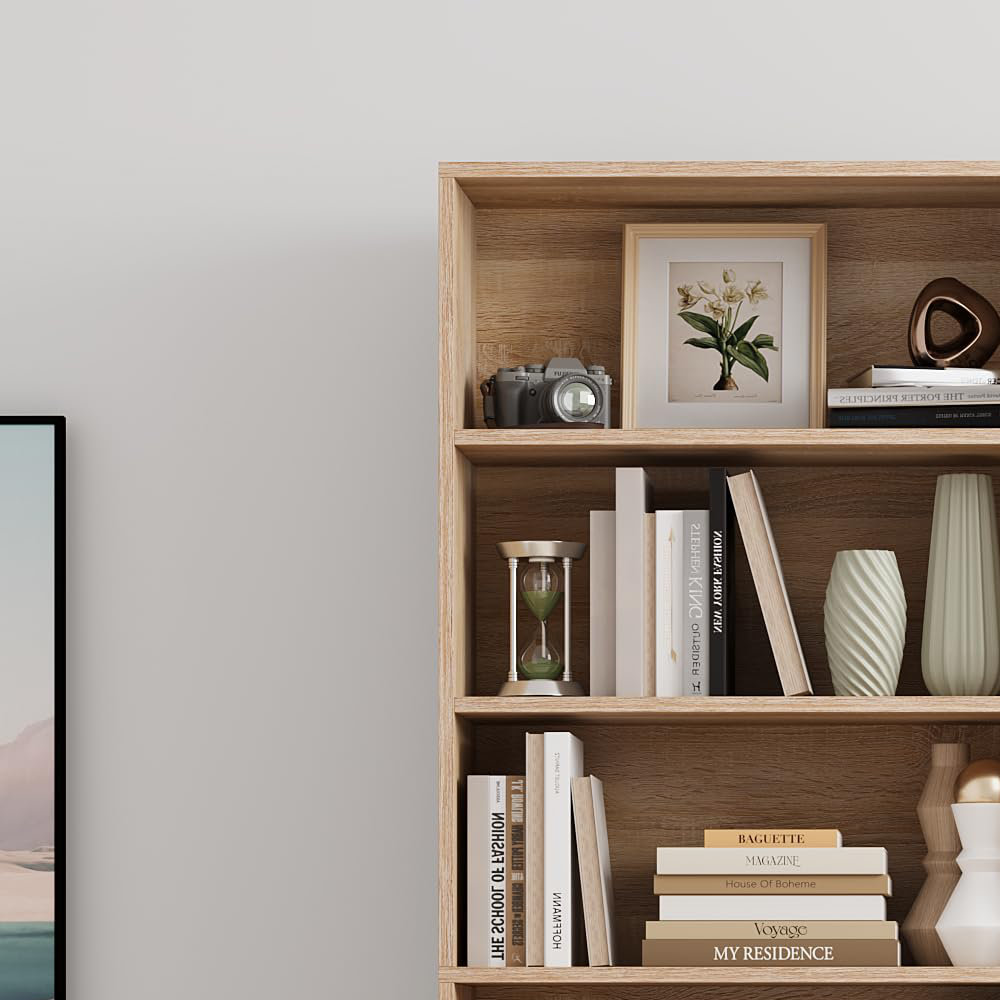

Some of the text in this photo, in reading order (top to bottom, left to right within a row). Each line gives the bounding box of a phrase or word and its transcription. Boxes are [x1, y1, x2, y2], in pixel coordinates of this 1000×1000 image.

[738, 834, 805, 844] BAGUETTE
[745, 855, 801, 868] MAGAZINE
[725, 879, 816, 889] House Of Boheme
[754, 922, 808, 939] Voyage
[713, 946, 835, 961] MY RESIDENCE
